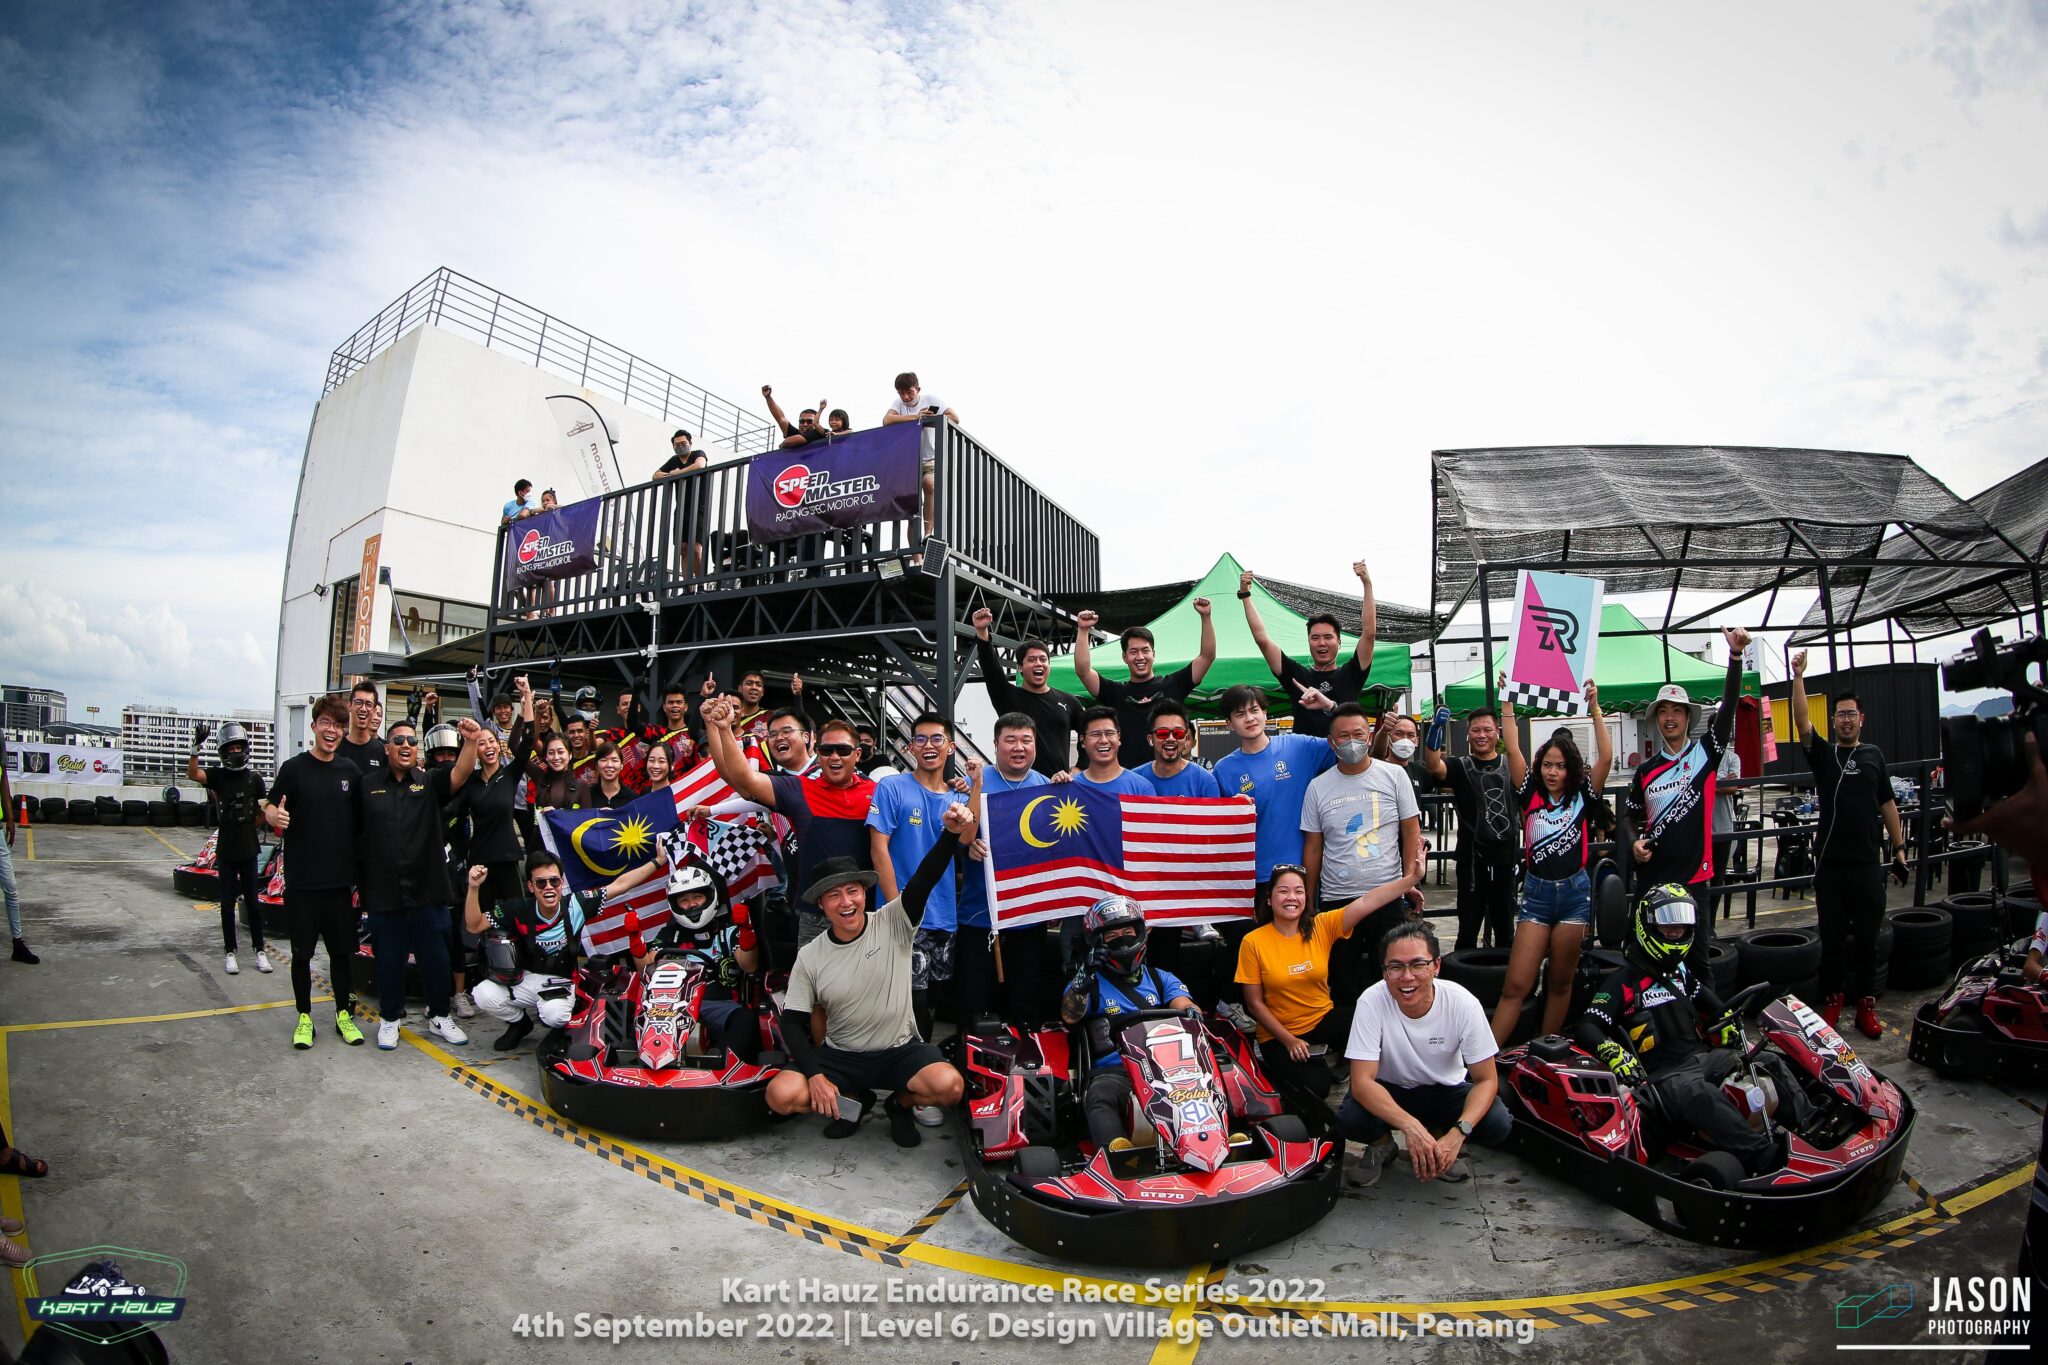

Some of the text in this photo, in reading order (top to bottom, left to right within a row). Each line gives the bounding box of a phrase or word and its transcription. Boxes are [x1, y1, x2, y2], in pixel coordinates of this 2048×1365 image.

[778, 471, 830, 495] SPEED
[805, 476, 875, 503] MASTER
[775, 506, 810, 523] RACING
[827, 496, 860, 512] MOTOR
[860, 493, 876, 505] OIL
[521, 537, 550, 554] SPEED
[535, 541, 572, 561] MASTER
[1545, 823, 1579, 855] ROCKET
[1849, 1143, 1875, 1157] GT270
[1140, 1191, 1185, 1200] GT270
